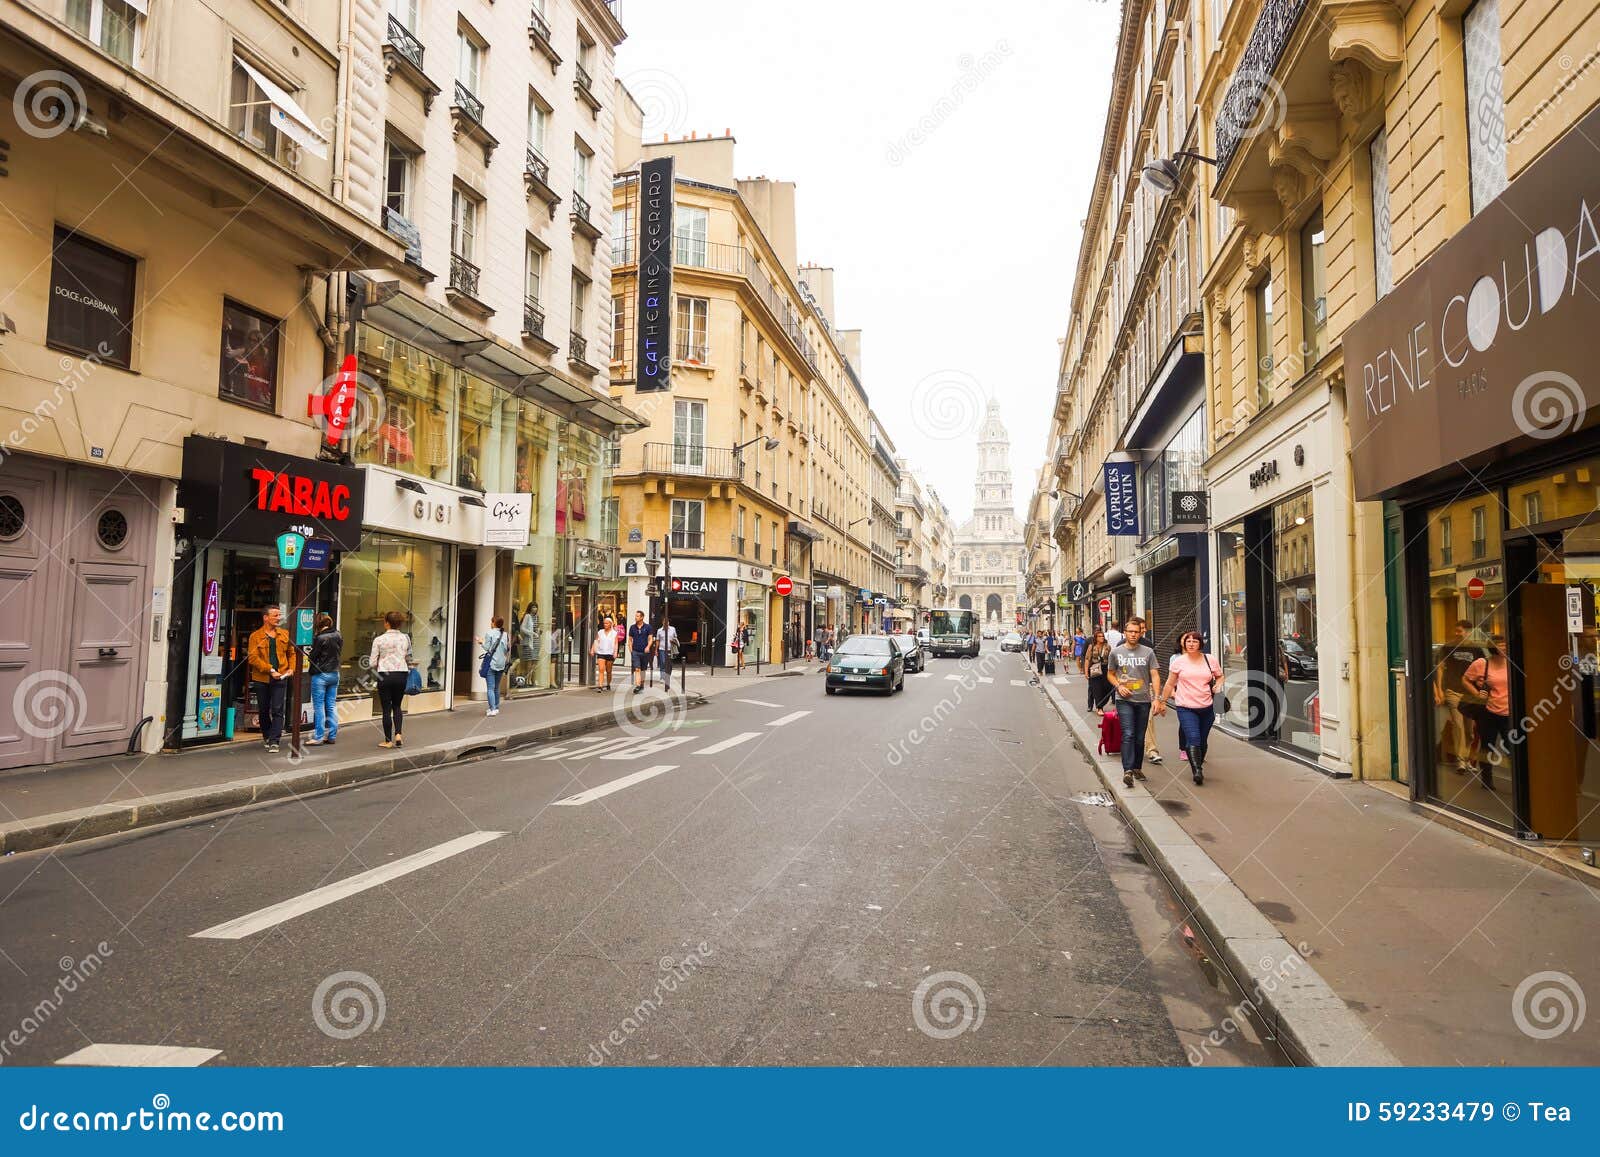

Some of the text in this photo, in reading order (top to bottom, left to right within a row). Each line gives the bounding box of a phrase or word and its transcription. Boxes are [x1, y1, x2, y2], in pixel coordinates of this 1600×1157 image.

[646, 171, 661, 376] CATHERINE GERARD
[55, 286, 80, 302] DOLCE
[83, 296, 118, 315] GABBANA
[1363, 320, 1430, 420] RENE
[332, 372, 351, 426] TABAC
[252, 468, 350, 521] TABAC
[414, 499, 452, 524] GIGI
[493, 501, 521, 523] Gigi
[1108, 468, 1122, 530] CAPRICES
[1121, 474, 1135, 526] d'ANTIN
[207, 595, 216, 637] TABAC
